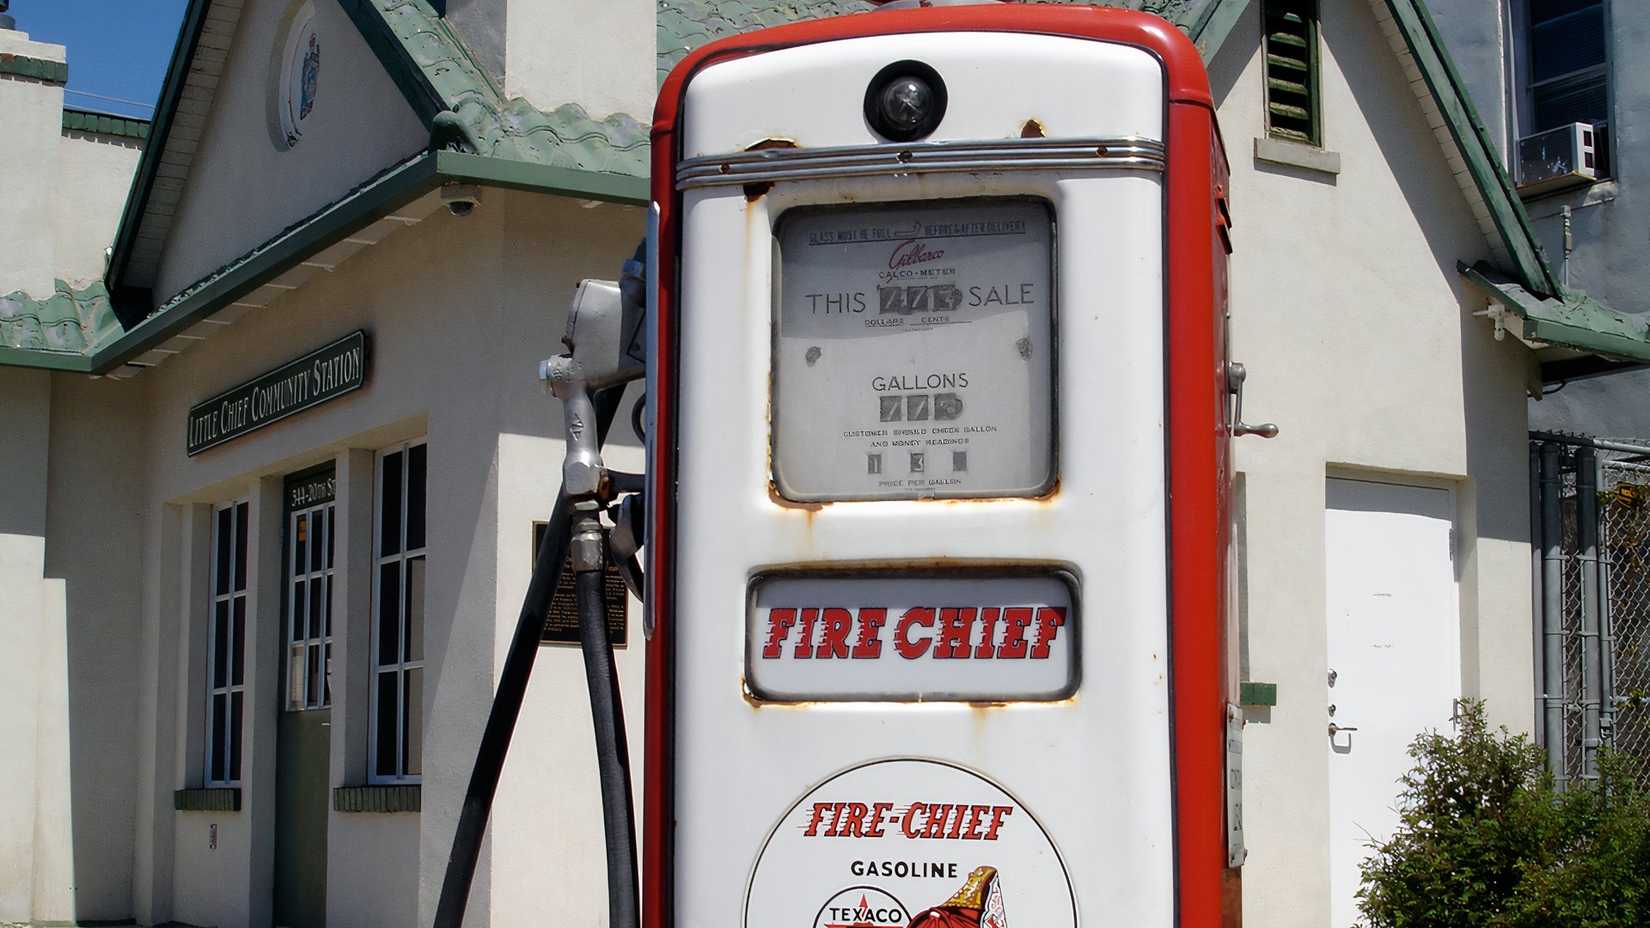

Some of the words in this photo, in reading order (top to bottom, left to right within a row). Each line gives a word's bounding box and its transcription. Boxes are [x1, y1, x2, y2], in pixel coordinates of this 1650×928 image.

[805, 292, 866, 314] THIS
[968, 283, 1035, 306] SALE
[871, 372, 969, 392] GALLONS
[188, 409, 219, 448] LITTLE
[220, 396, 249, 434] CHIEF
[251, 369, 312, 422] COMMUNITY
[313, 346, 360, 396] STATION
[762, 606, 888, 660] FIRE
[894, 606, 1067, 660] CHIEF
[850, 860, 958, 879] GASOLINE
[829, 907, 902, 923] TEXACO
